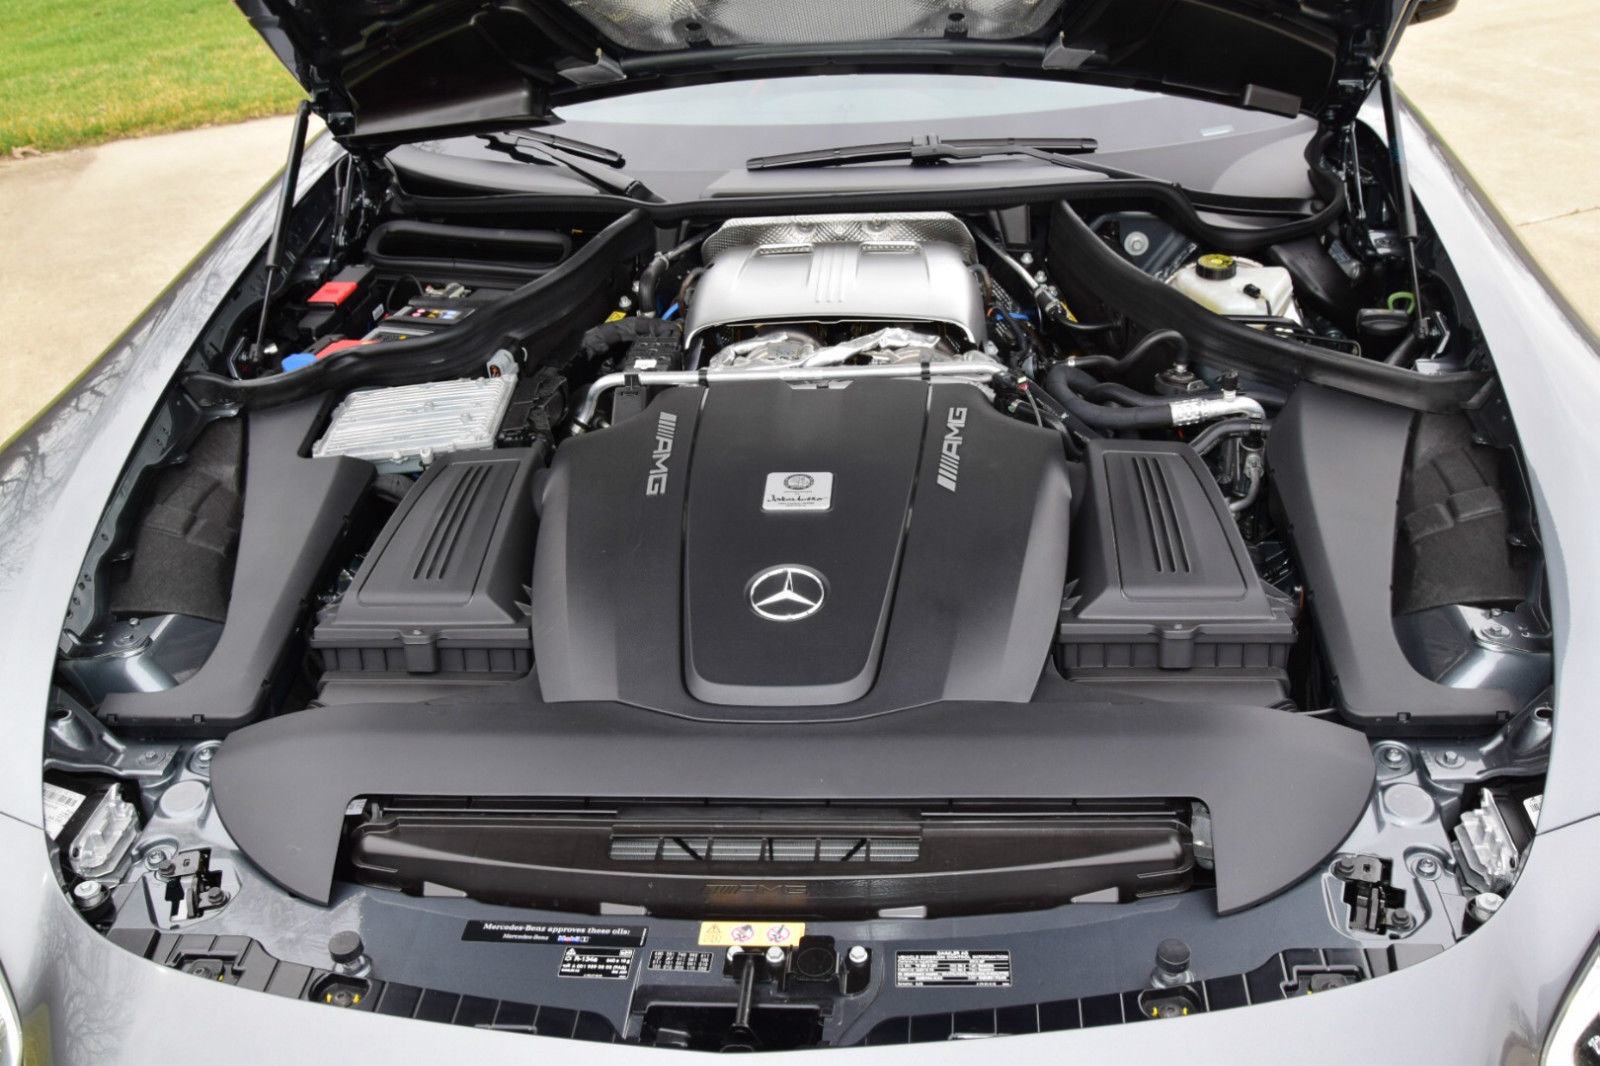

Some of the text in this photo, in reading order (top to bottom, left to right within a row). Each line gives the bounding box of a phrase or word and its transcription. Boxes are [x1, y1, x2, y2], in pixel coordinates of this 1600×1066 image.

[942, 407, 968, 463] AMG
[646, 435, 674, 496] AMG
[483, 922, 546, 933] Mercedes-Benz
[547, 926, 586, 935] approves
[587, 926, 611, 935] these
